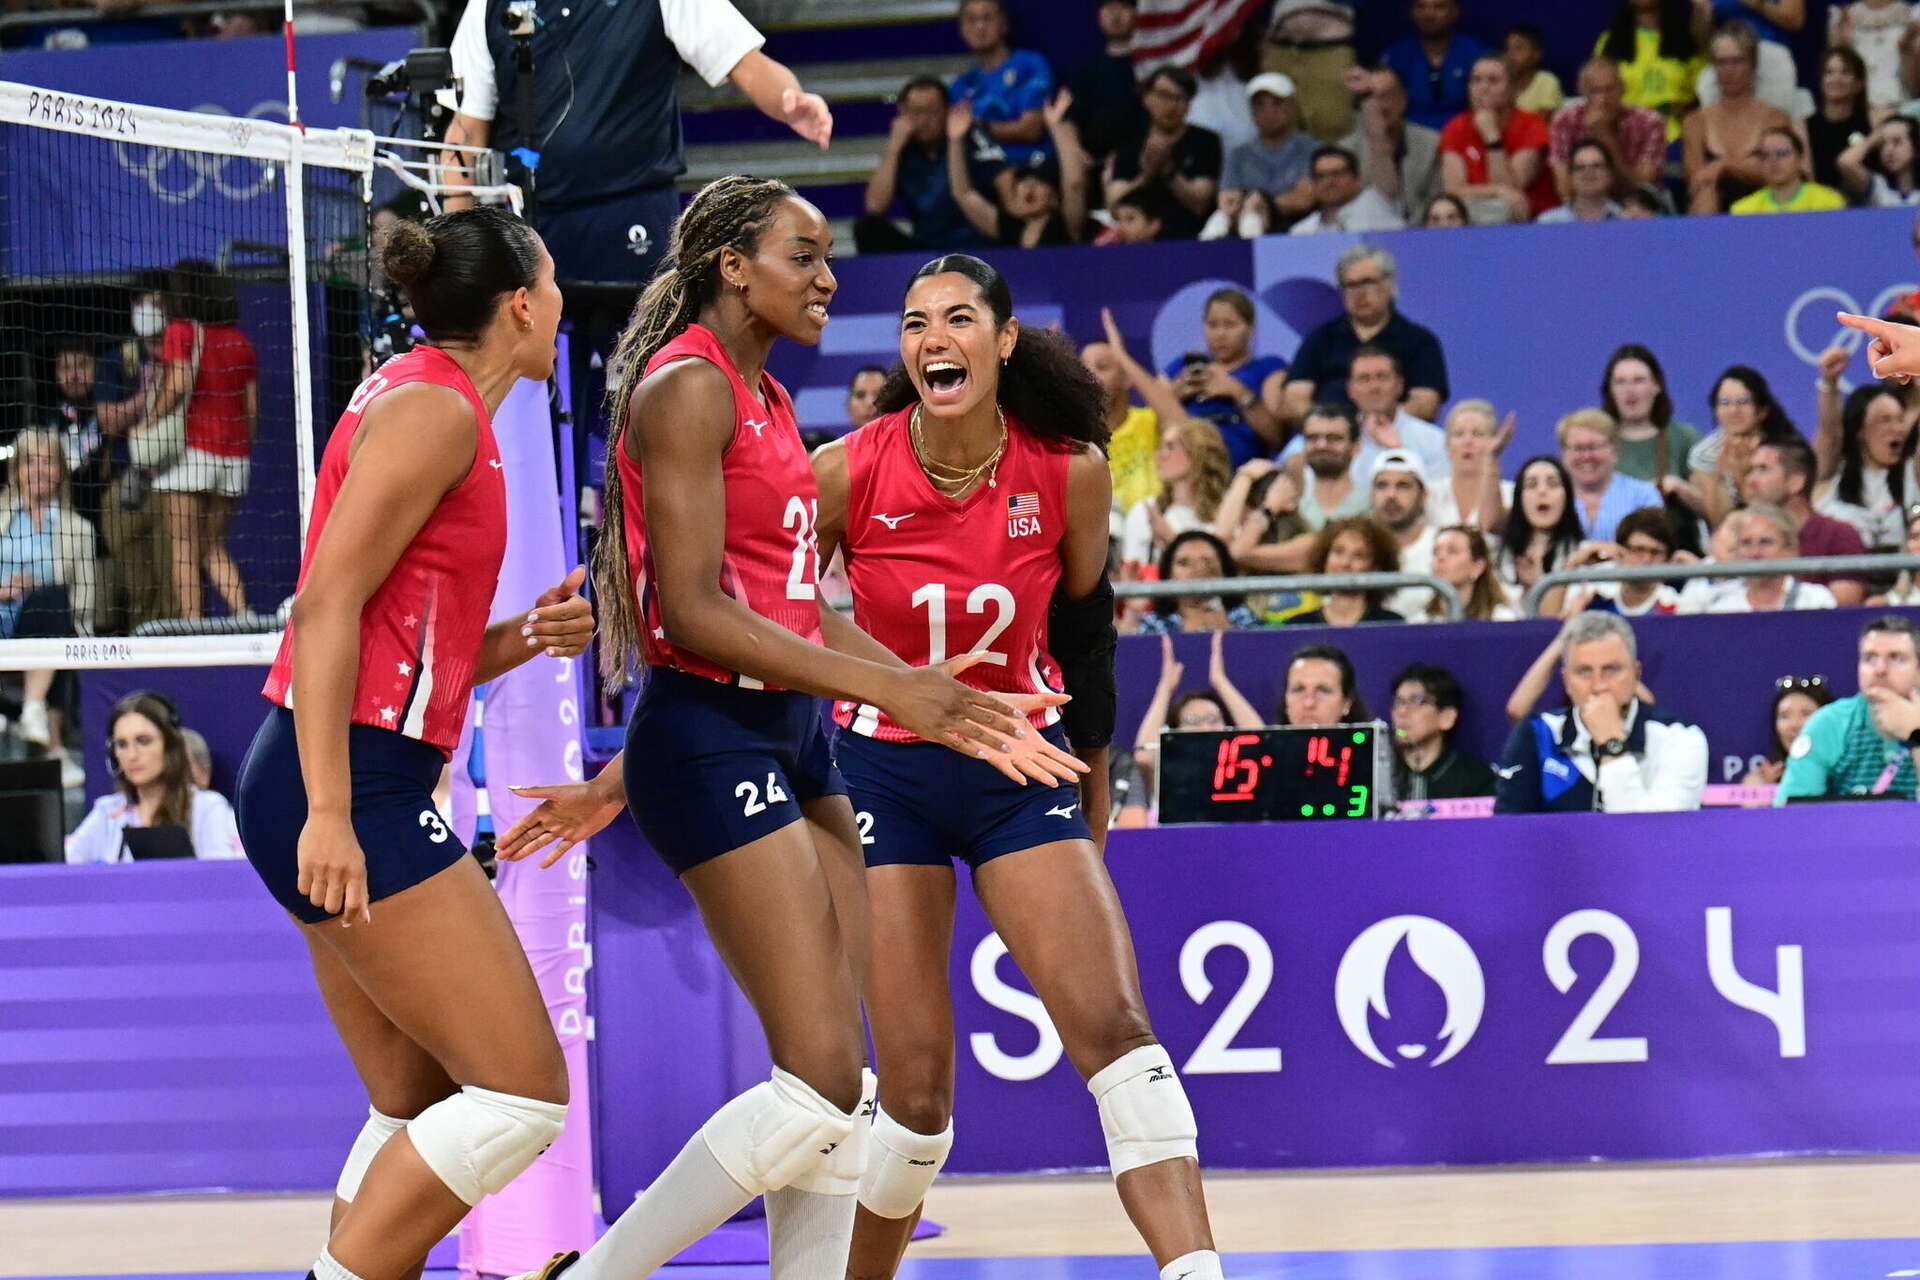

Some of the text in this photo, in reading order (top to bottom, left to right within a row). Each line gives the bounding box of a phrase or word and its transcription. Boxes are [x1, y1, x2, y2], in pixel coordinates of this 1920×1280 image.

[1008, 516, 1042, 538] USA
[911, 583, 1016, 667] 12
[735, 772, 789, 818] 24
[1347, 784, 1368, 817] 3
[418, 809, 448, 844] 3
